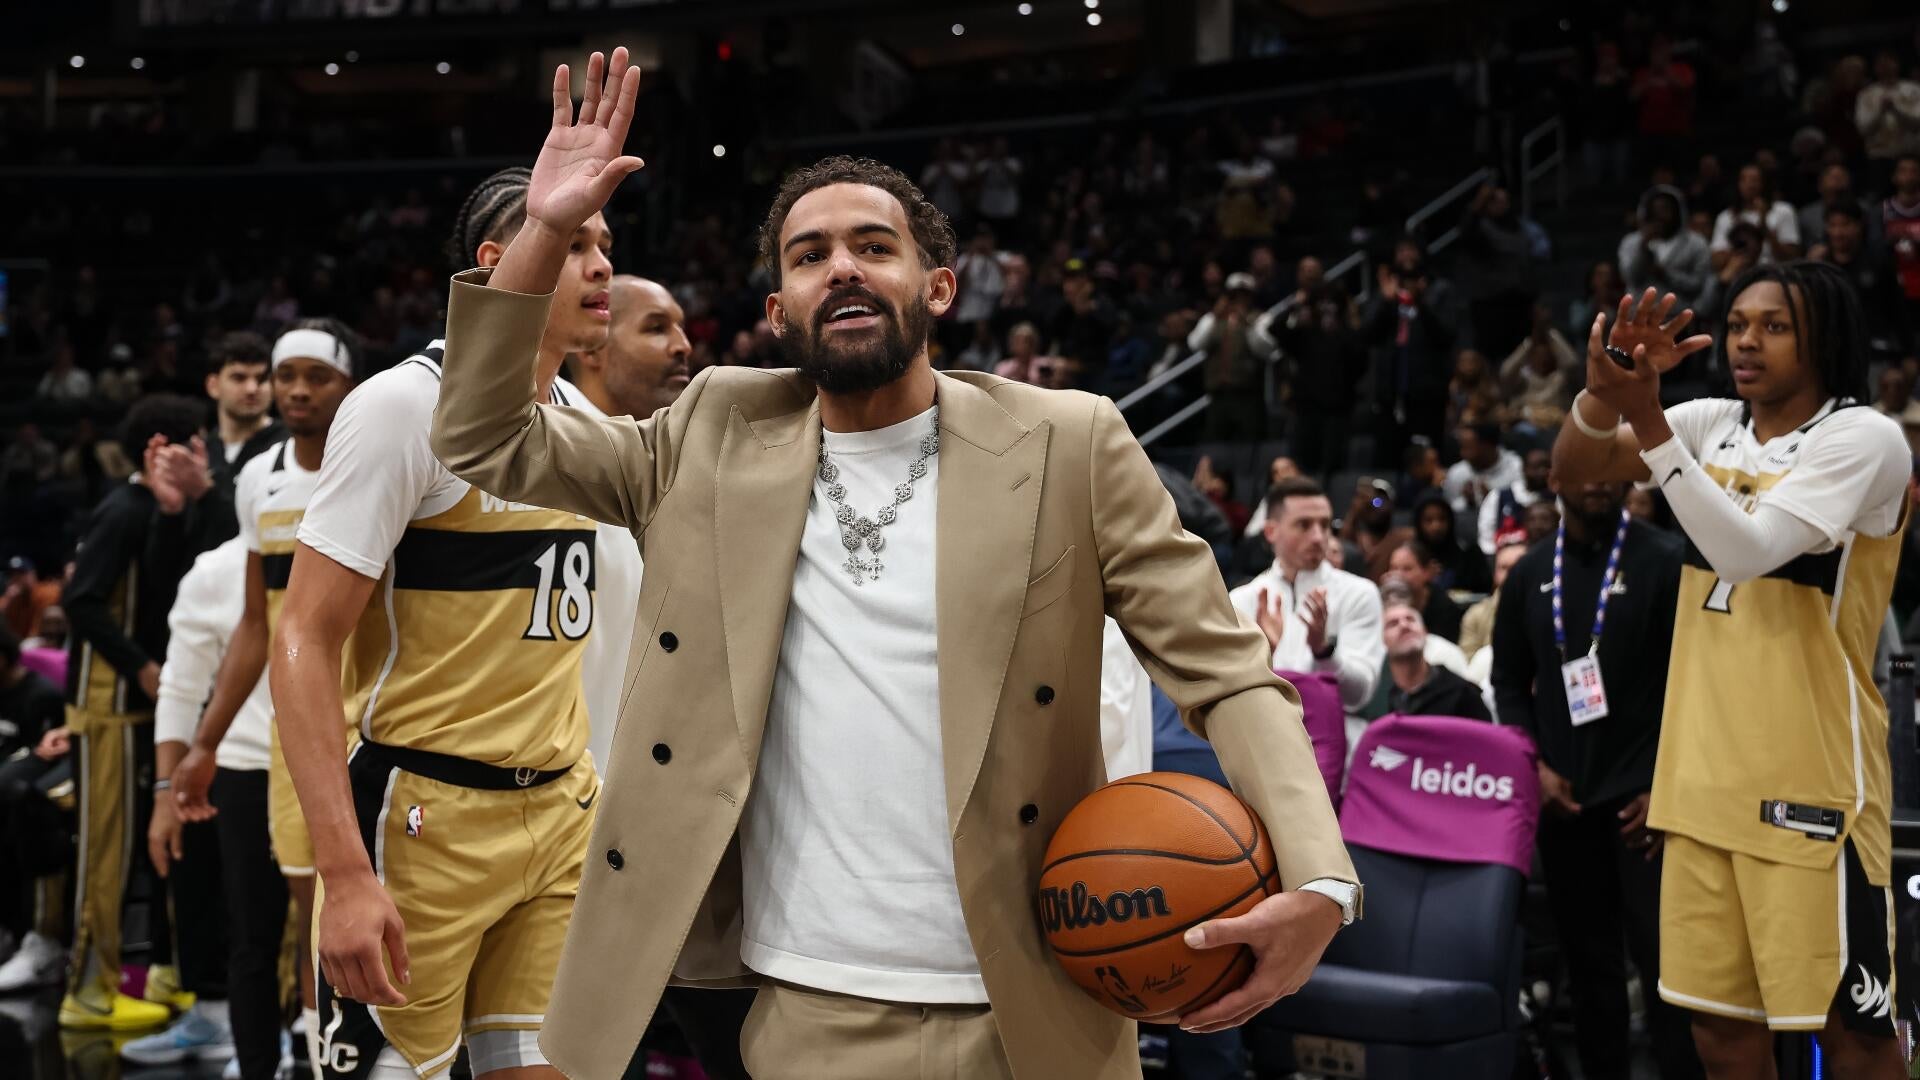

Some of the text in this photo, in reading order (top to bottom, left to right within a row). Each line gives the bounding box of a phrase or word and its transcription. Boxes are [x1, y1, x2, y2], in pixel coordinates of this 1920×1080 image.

[522, 540, 593, 641] 18
[1410, 756, 1514, 801] leidos
[1040, 881, 1171, 932] Wilson
